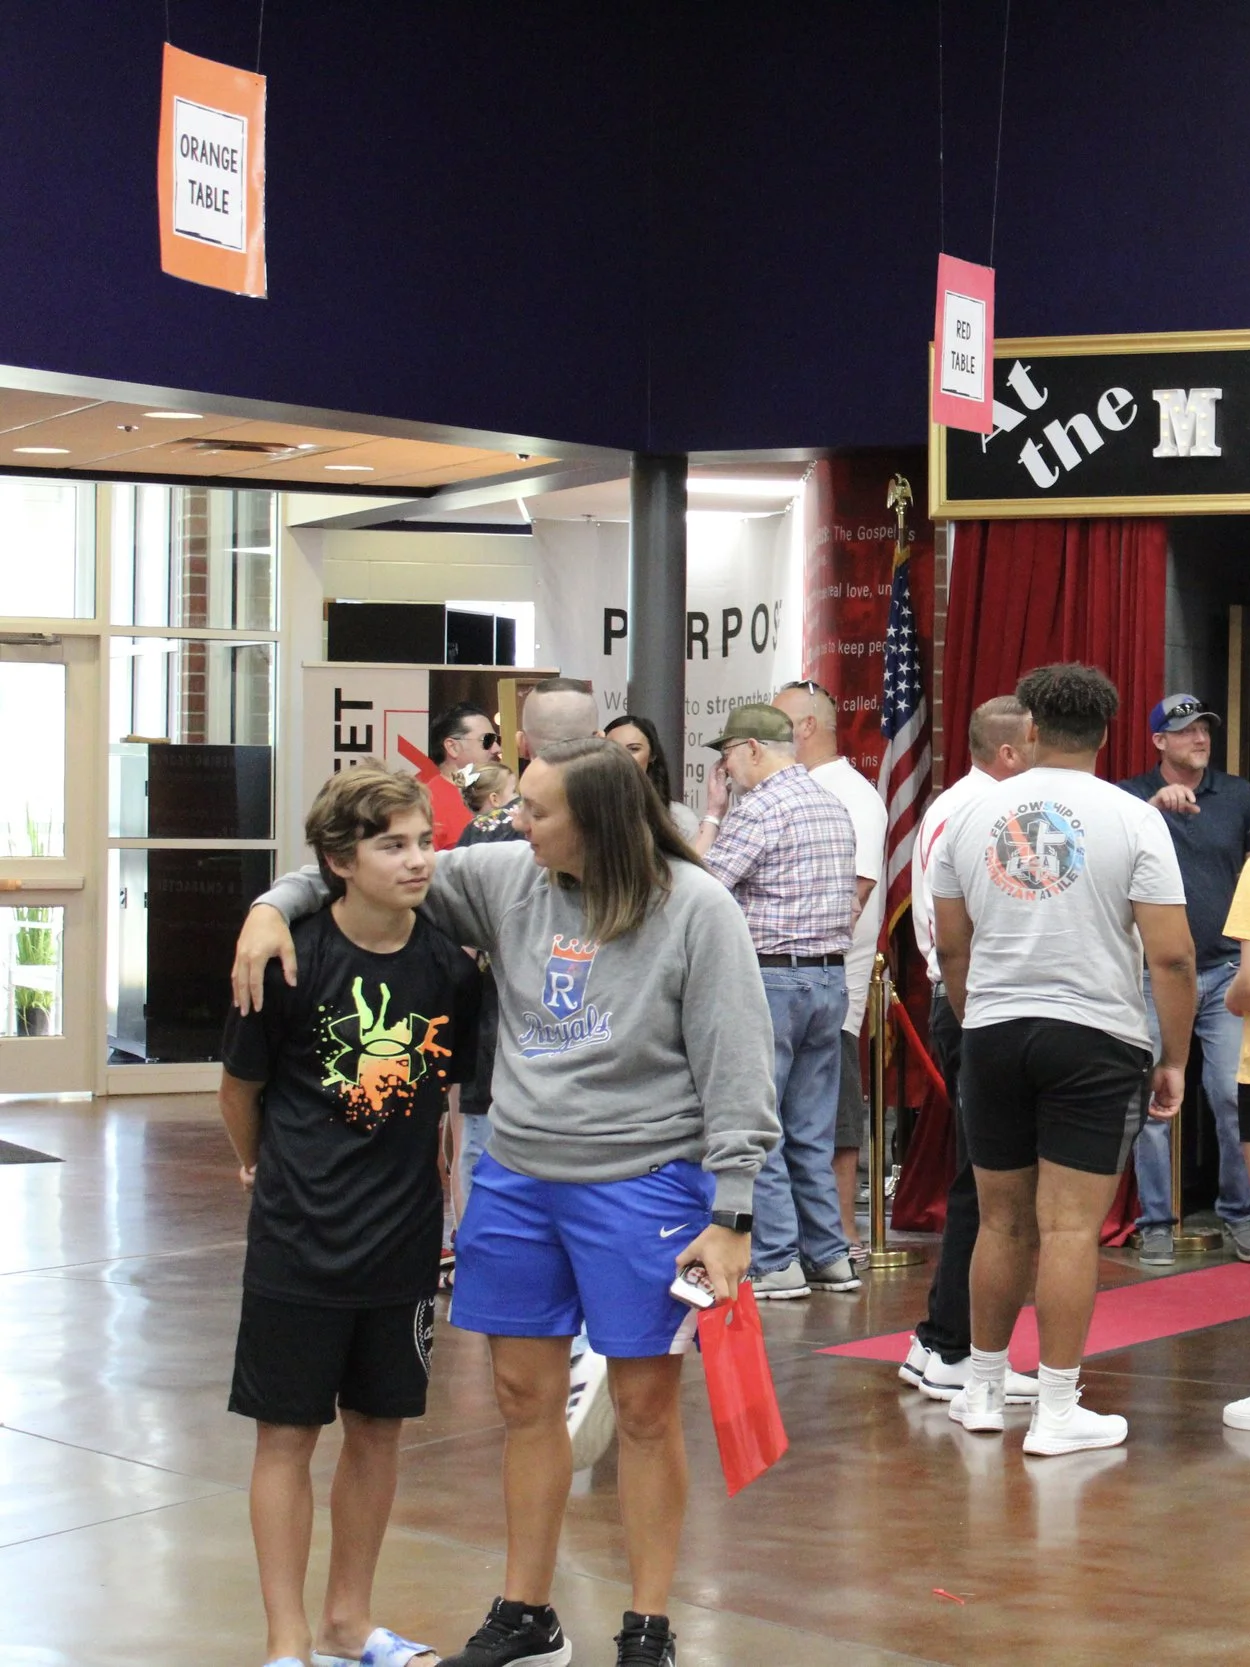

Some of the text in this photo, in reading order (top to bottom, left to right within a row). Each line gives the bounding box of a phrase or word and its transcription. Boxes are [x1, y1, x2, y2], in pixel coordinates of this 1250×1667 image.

[180, 133, 238, 173] ORANGE
[188, 179, 229, 215] TABLE
[956, 319, 971, 340] RED
[951, 351, 975, 375] TABLE
[1017, 387, 1138, 489] the
[834, 526, 852, 541] The
[857, 524, 897, 541] Gospel
[846, 583, 873, 599] love,
[838, 640, 864, 658] keep
[685, 696, 701, 716] to
[843, 695, 880, 712] called,
[547, 971, 578, 1010] R
[518, 1003, 613, 1054] Royals
